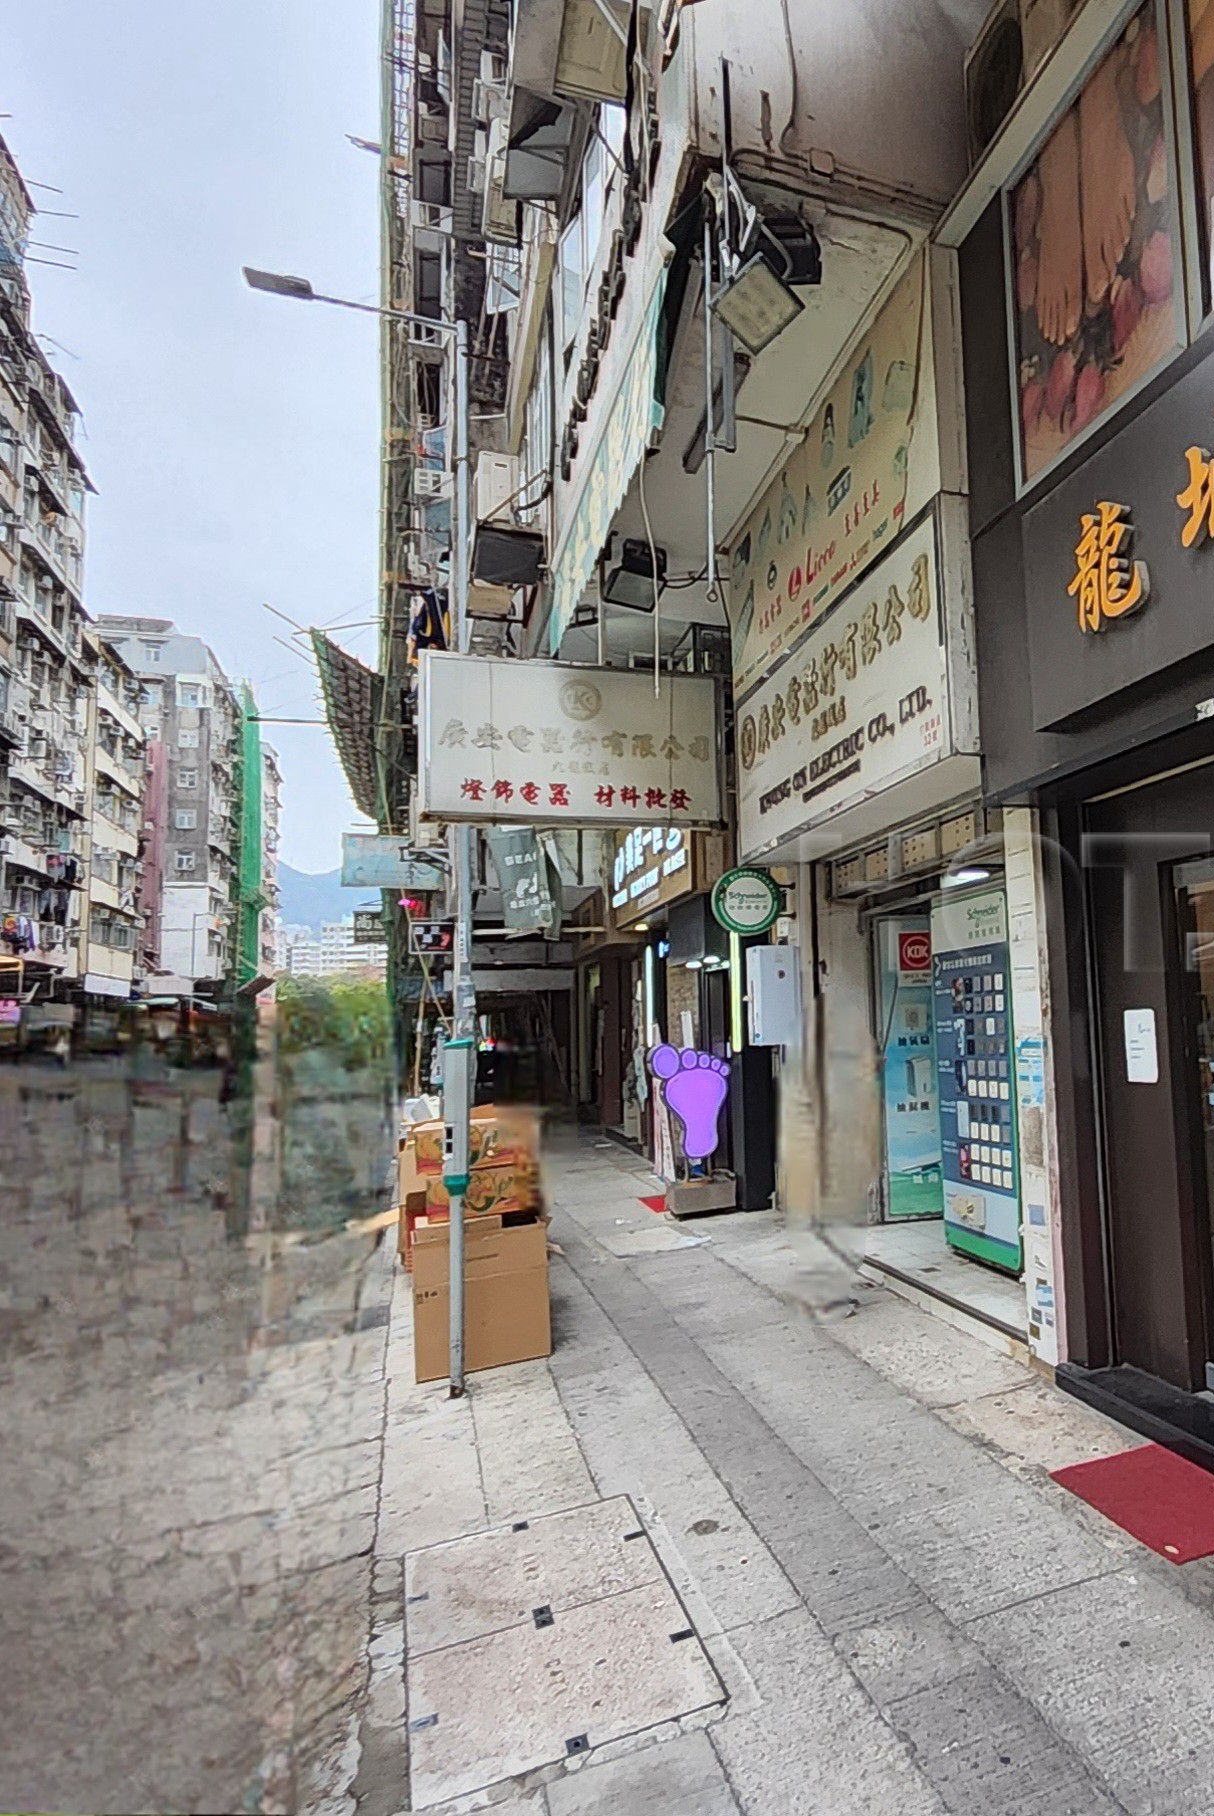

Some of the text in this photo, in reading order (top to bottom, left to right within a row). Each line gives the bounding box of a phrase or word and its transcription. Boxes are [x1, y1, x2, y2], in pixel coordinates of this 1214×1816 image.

[593, 784, 693, 811] 材料批發
[907, 945, 929, 958] KDK
